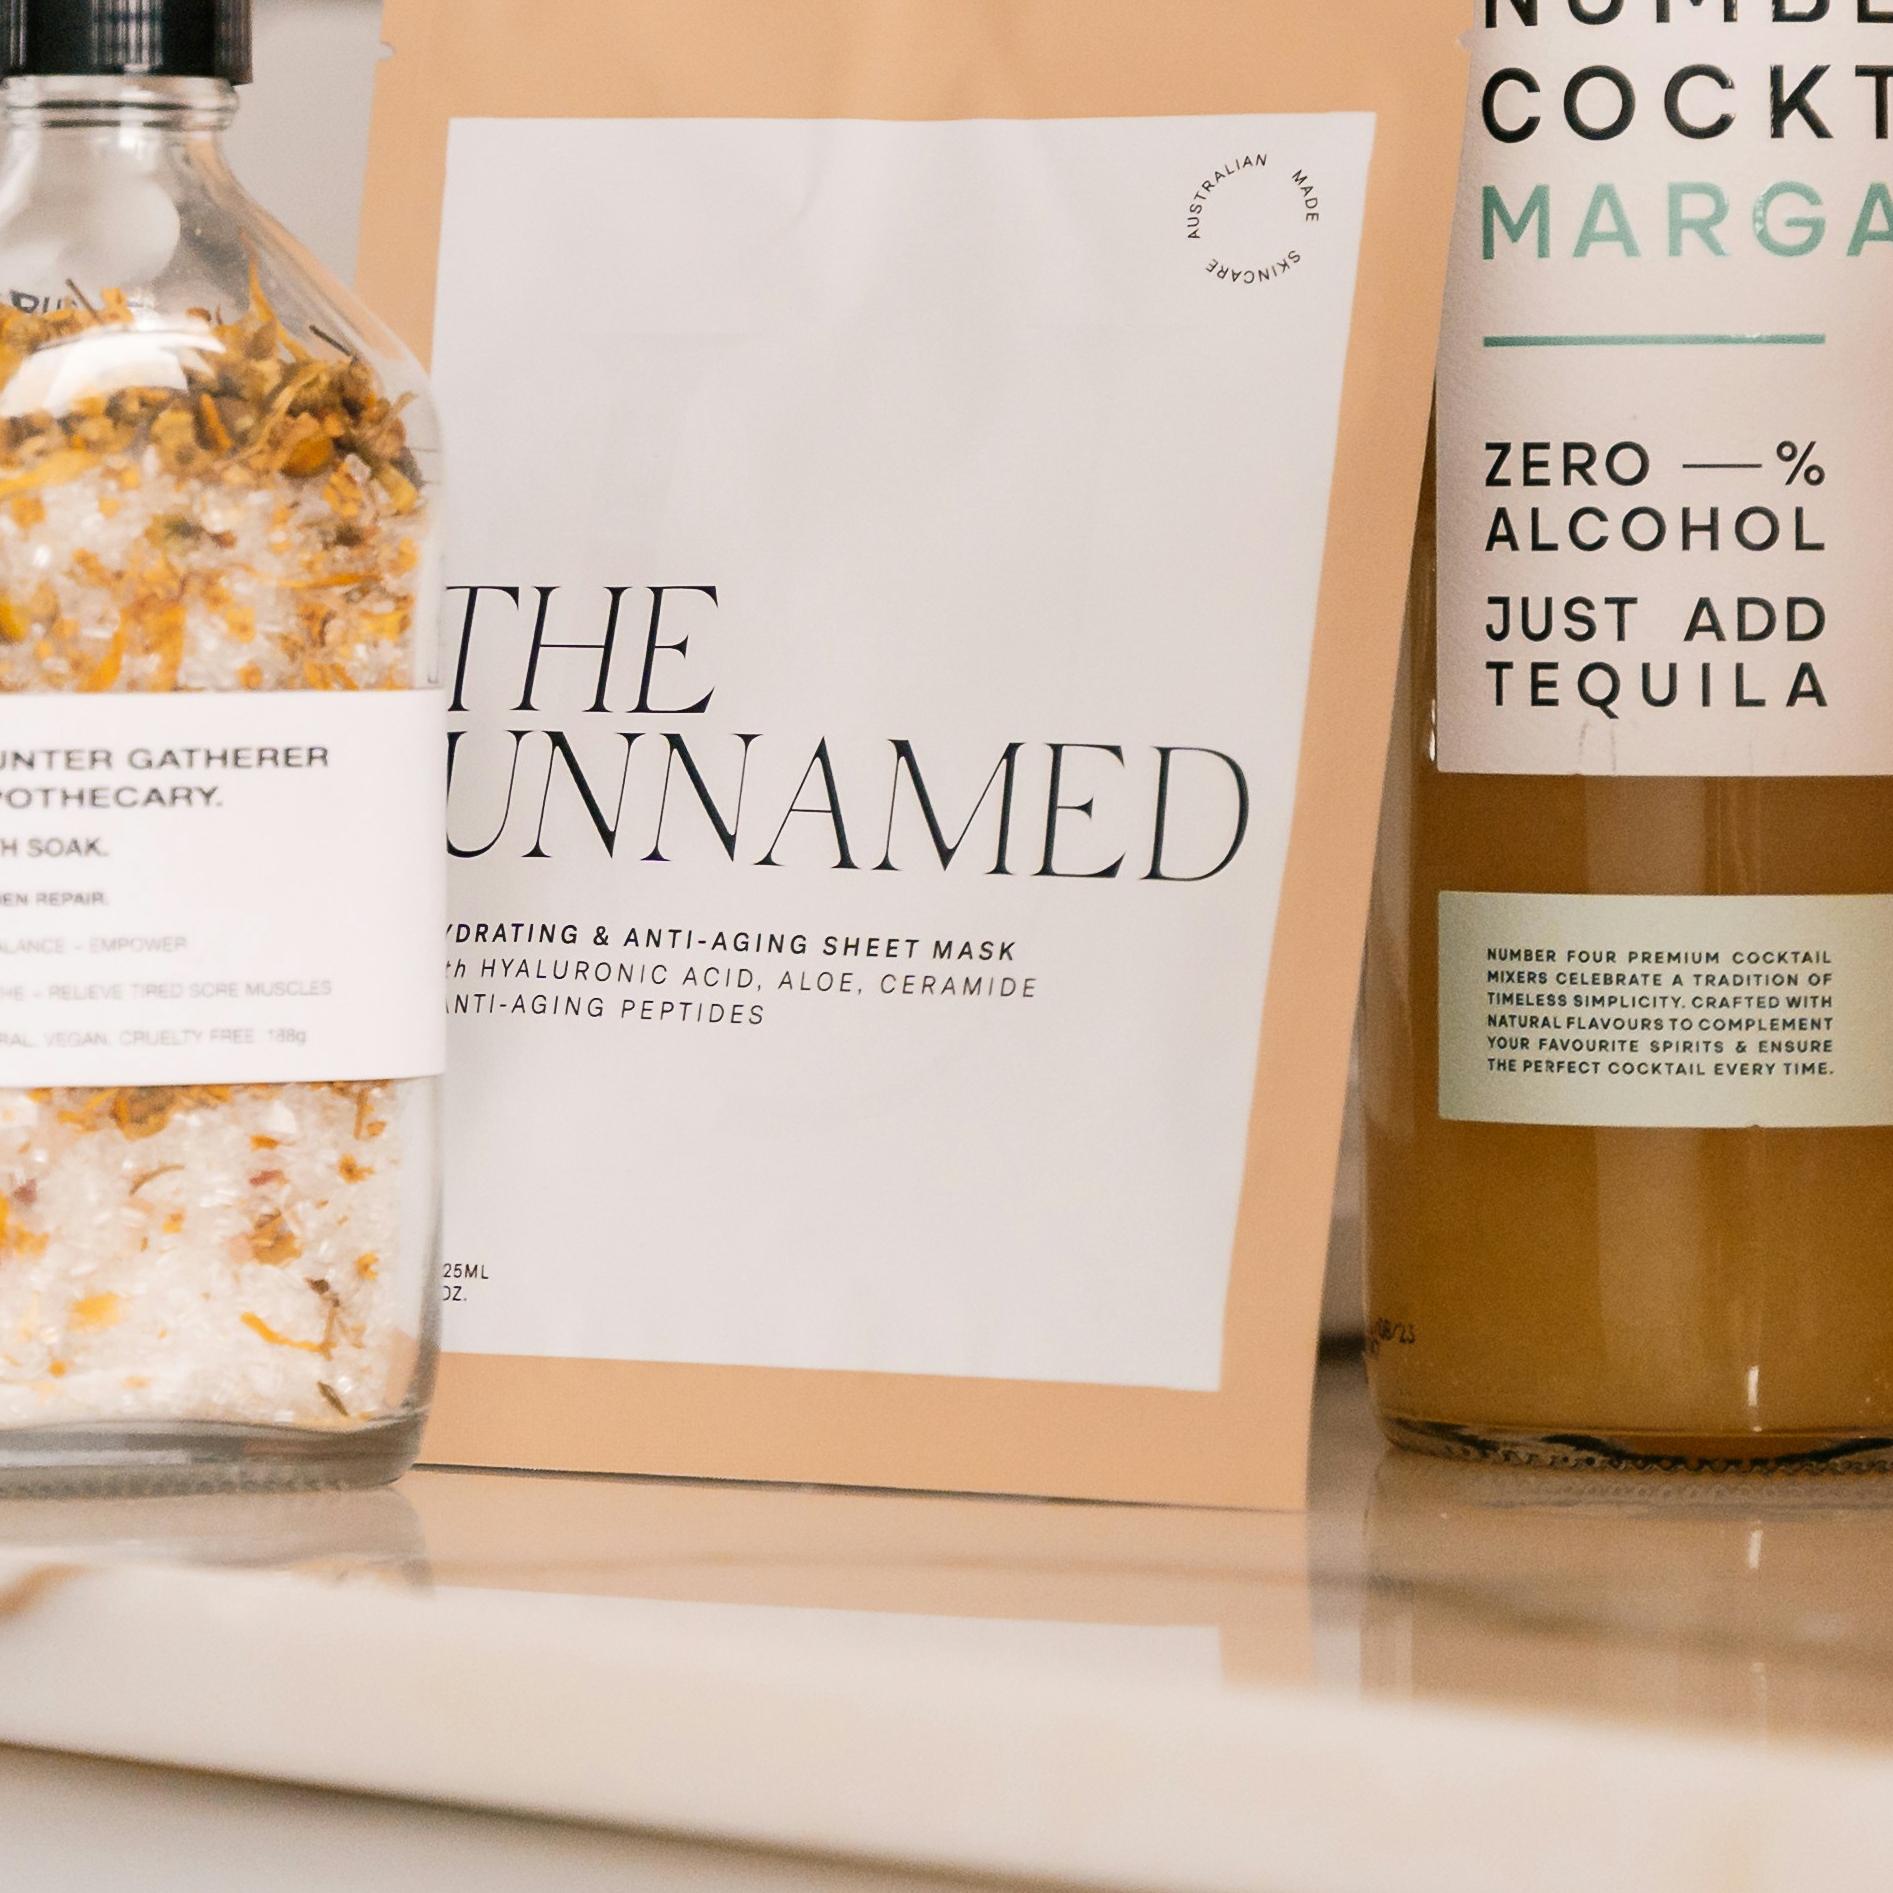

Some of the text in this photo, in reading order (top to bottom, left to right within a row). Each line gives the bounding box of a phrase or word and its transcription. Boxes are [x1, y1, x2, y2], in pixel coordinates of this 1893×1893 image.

[1187, 154, 1319, 283] AUSTRALIAN MADE SKINCARE
[1484, 441, 1650, 488] ZERO
[1484, 505, 1825, 552] ALCOHOL
[1485, 595, 1826, 643] JUST ADD
[447, 585, 718, 714] THE
[1485, 660, 1828, 720] TEQUILA
[128, 746, 329, 769] GATHERER
[446, 730, 1250, 881] UNNAMED
[28, 838, 109, 858] SOAK.
[90, 937, 187, 953] EMPOWER
[592, 925, 609, 946] &
[622, 927, 807, 955] ANTI-AGING
[822, 935, 920, 959] SHEET
[932, 940, 1016, 961] MASK
[1486, 947, 1832, 965] NUMBER FOUR PREMIUM COCKTAIL
[480, 958, 668, 985] HYALURONIC
[682, 966, 761, 992] ACID,
[777, 970, 862, 995] ALOE,
[880, 973, 1037, 998] CERAMIDE
[1486, 969, 1833, 987] MIXERS CELEBRATE A TRADITION OF
[49, 984, 124, 1000] RELIEVE
[132, 984, 184, 999] TIRED
[189, 982, 238, 997] SORE
[245, 980, 331, 996] MUSCLES
[1486, 991, 1832, 1009] TIMELESS SIMPLICITY. CRAFTED WITH
[621, 999, 764, 1025] PEPTIDES
[1485, 1013, 1834, 1032] NATURAL FLAVOURS TO COMPLEMENT
[120, 1030, 202, 1046] CRUELTY
[210, 1030, 255, 1044] FREE
[1486, 1035, 1833, 1054] YOUR FAVOURITE SPIRITS & ENSURE
[1487, 1057, 1834, 1076] THE PERFECT COCKTAIL EVERY TIME.
